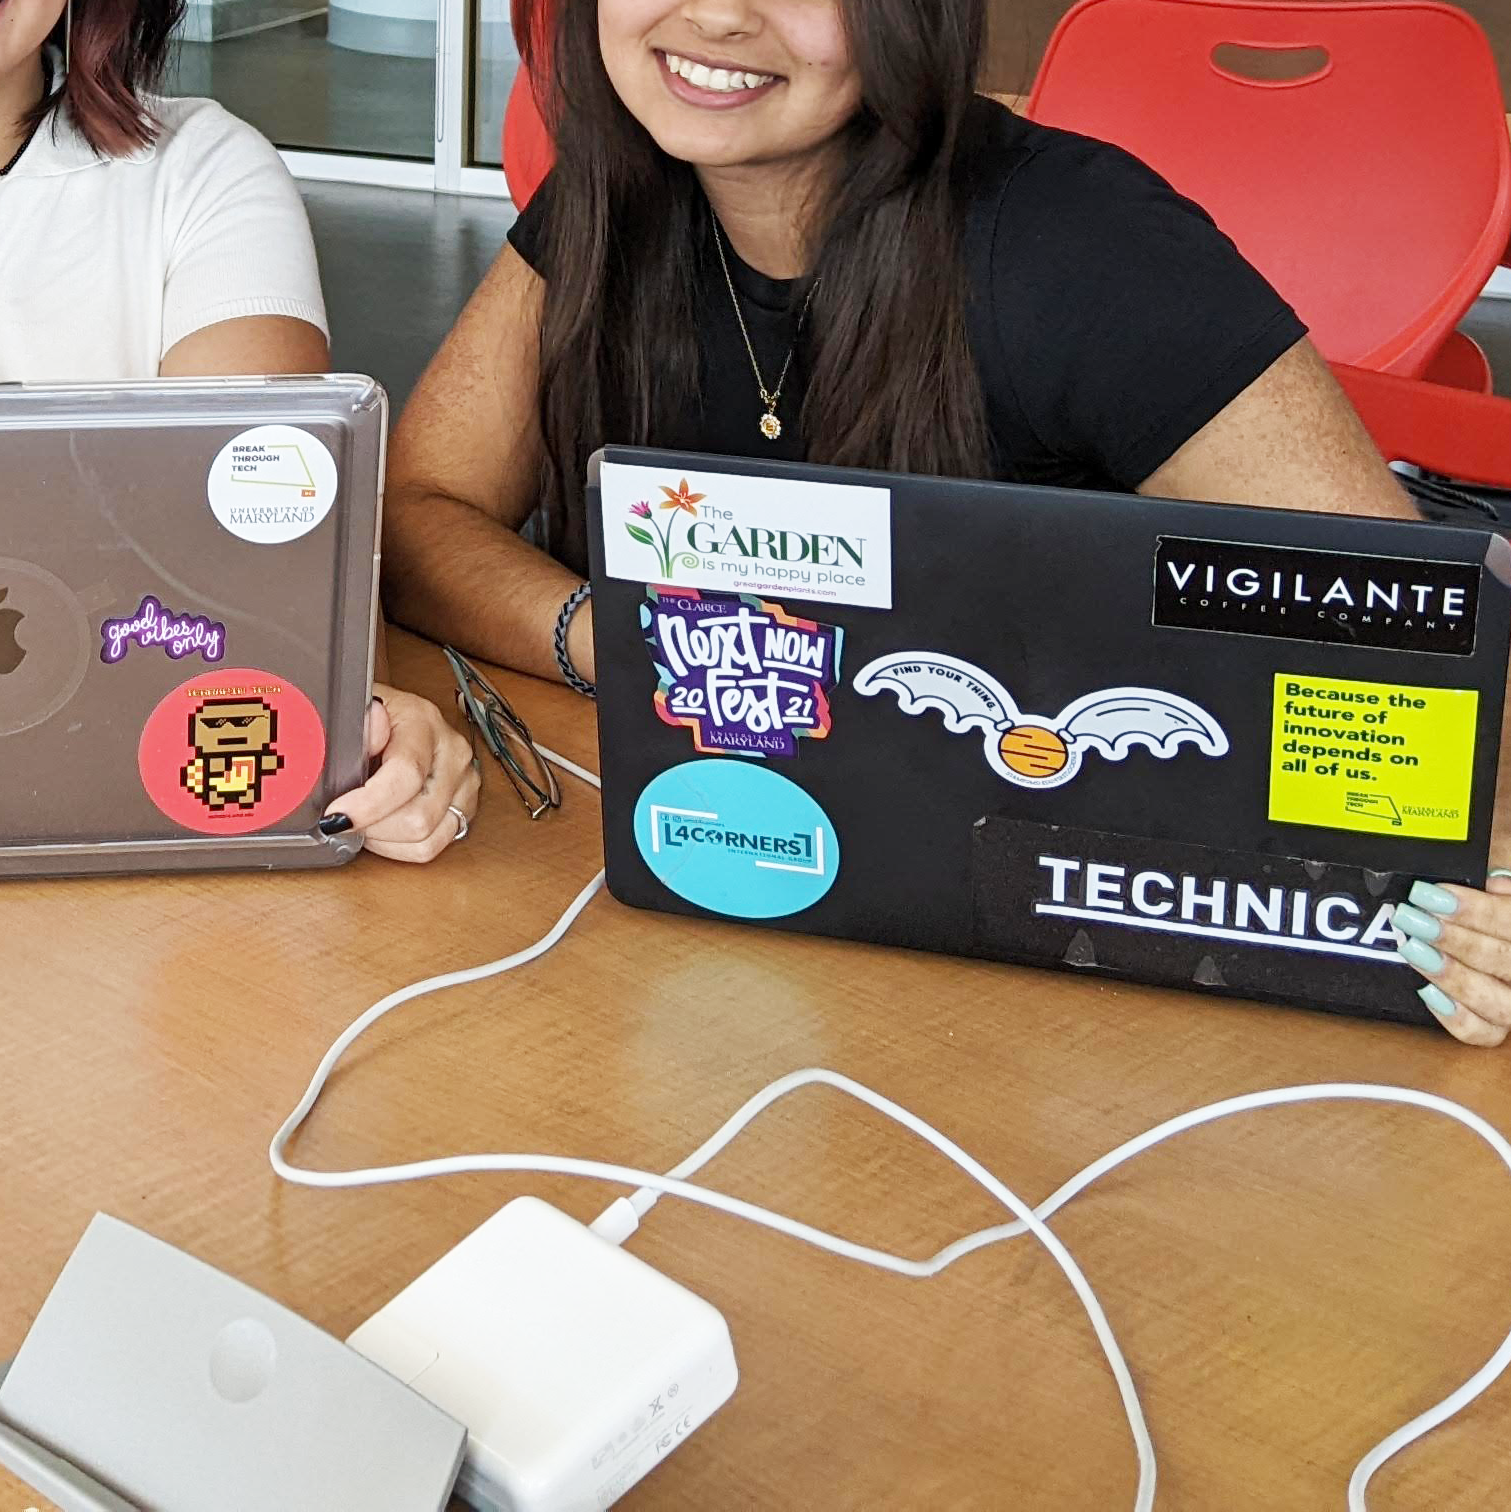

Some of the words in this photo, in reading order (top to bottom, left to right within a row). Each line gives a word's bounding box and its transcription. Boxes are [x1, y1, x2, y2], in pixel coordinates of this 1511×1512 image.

[230, 506, 299, 514] UNIVERSITY
[230, 512, 315, 524] MARYLAND
[700, 504, 734, 520] The
[686, 521, 867, 569] GARDEN
[702, 557, 715, 570] is
[721, 561, 749, 576] my
[755, 562, 810, 583] happy
[817, 570, 866, 586] place
[733, 579, 837, 597] greatgardenplants.com
[1167, 561, 1466, 617] VIGILANTE
[677, 599, 727, 614] CLARICE
[1179, 596, 1286, 615] COFFEE
[1317, 610, 1457, 631] COMPANY
[108, 602, 158, 658] good
[141, 615, 196, 645] vibes
[172, 622, 220, 658] only
[657, 607, 770, 677] Next
[764, 627, 826, 669] NOW
[892, 665, 922, 676] FIND
[927, 666, 963, 683] YOUR
[671, 686, 704, 708] 20
[706, 667, 810, 733] Fest
[784, 696, 813, 717] 21
[1284, 682, 1380, 705] Because
[1387, 693, 1427, 710] the
[1283, 701, 1355, 722] future
[1362, 710, 1388, 725] of
[710, 735, 785, 750] MARYLAND
[1283, 720, 1405, 746] innovation
[1282, 740, 1383, 767] depends
[1389, 752, 1419, 767] on
[1281, 759, 1307, 774] all
[1314, 761, 1339, 776] of
[1345, 767, 1378, 782] us.
[1037, 855, 1408, 948] TECHNICA
